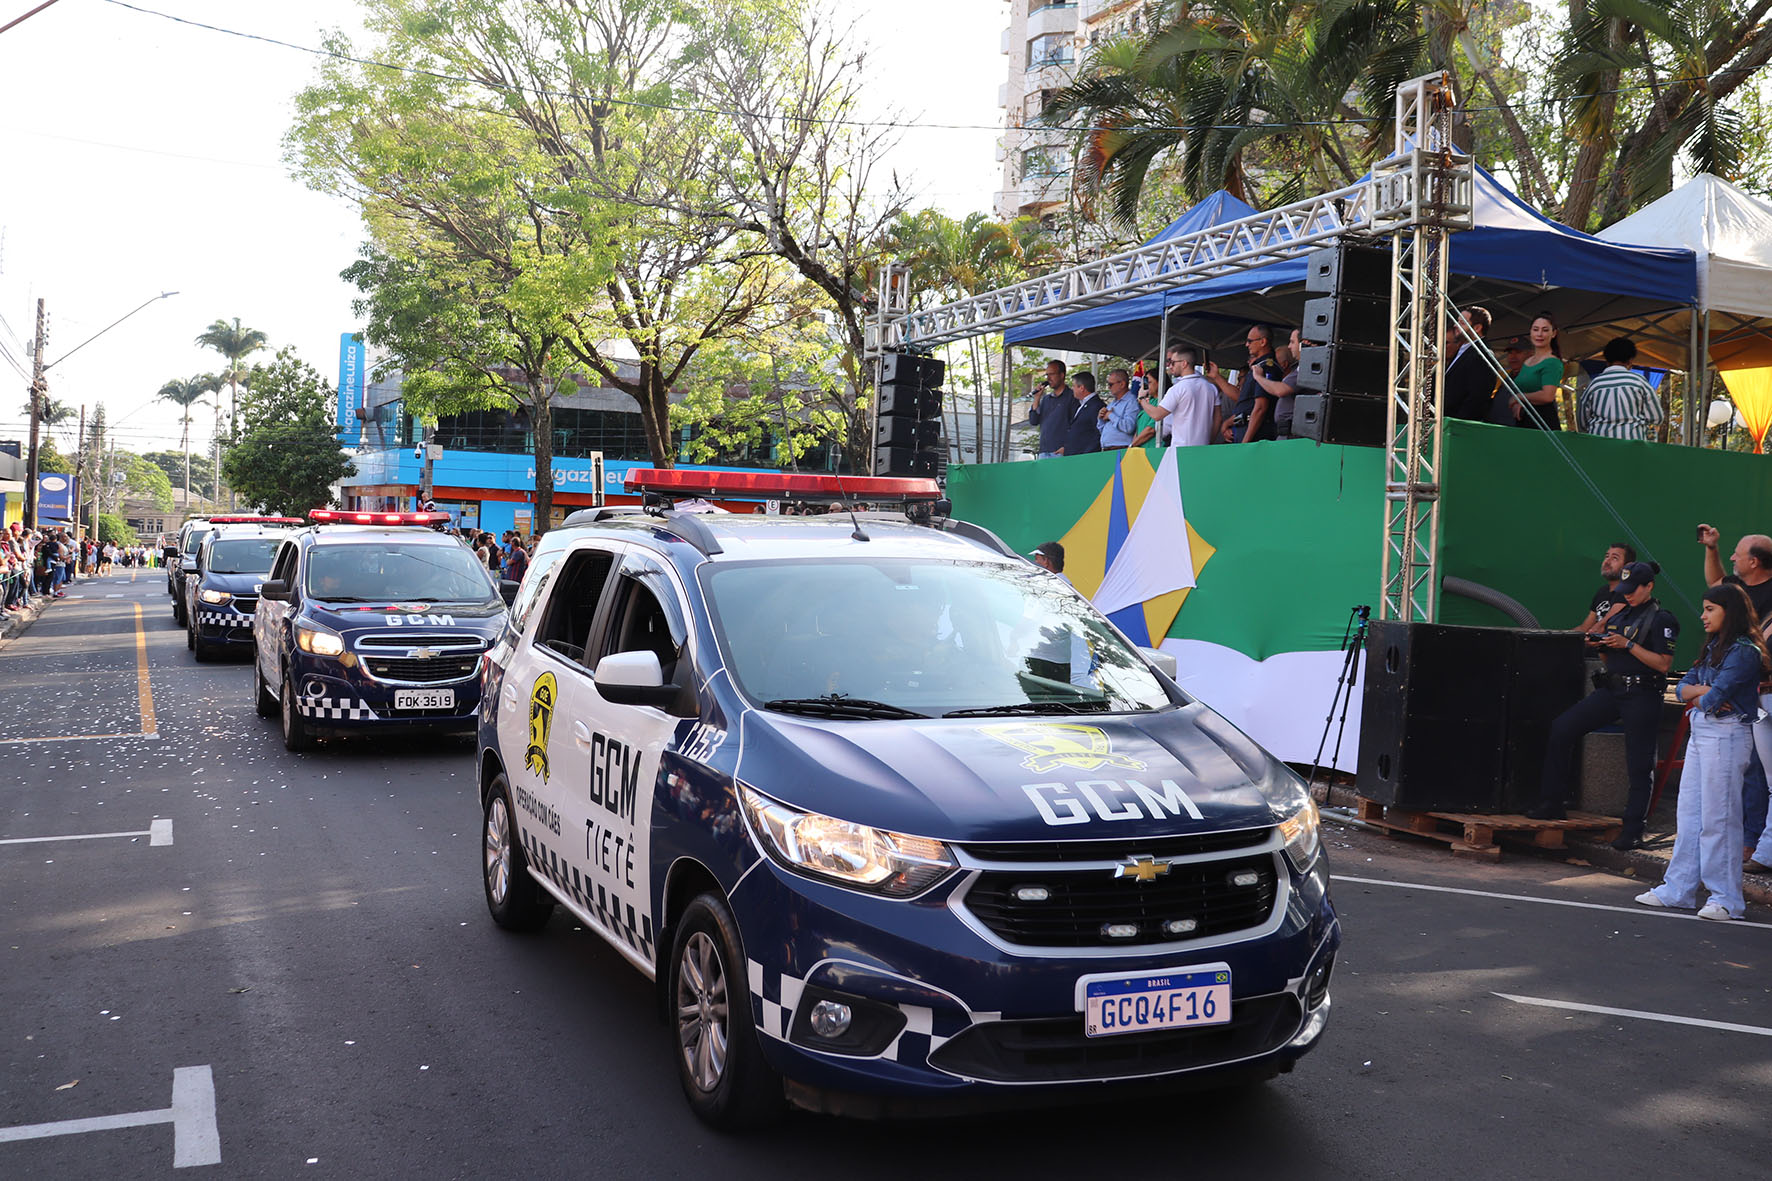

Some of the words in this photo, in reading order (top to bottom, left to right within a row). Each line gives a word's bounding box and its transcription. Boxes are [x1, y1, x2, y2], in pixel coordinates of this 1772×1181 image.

[384, 614, 456, 626] GCM
[590, 731, 642, 826] GCM
[1021, 779, 1204, 826] GCM
[585, 818, 635, 890] TIETÊ
[1147, 978, 1171, 988] BRASIL
[1101, 990, 1216, 1028] GCQ4F16
